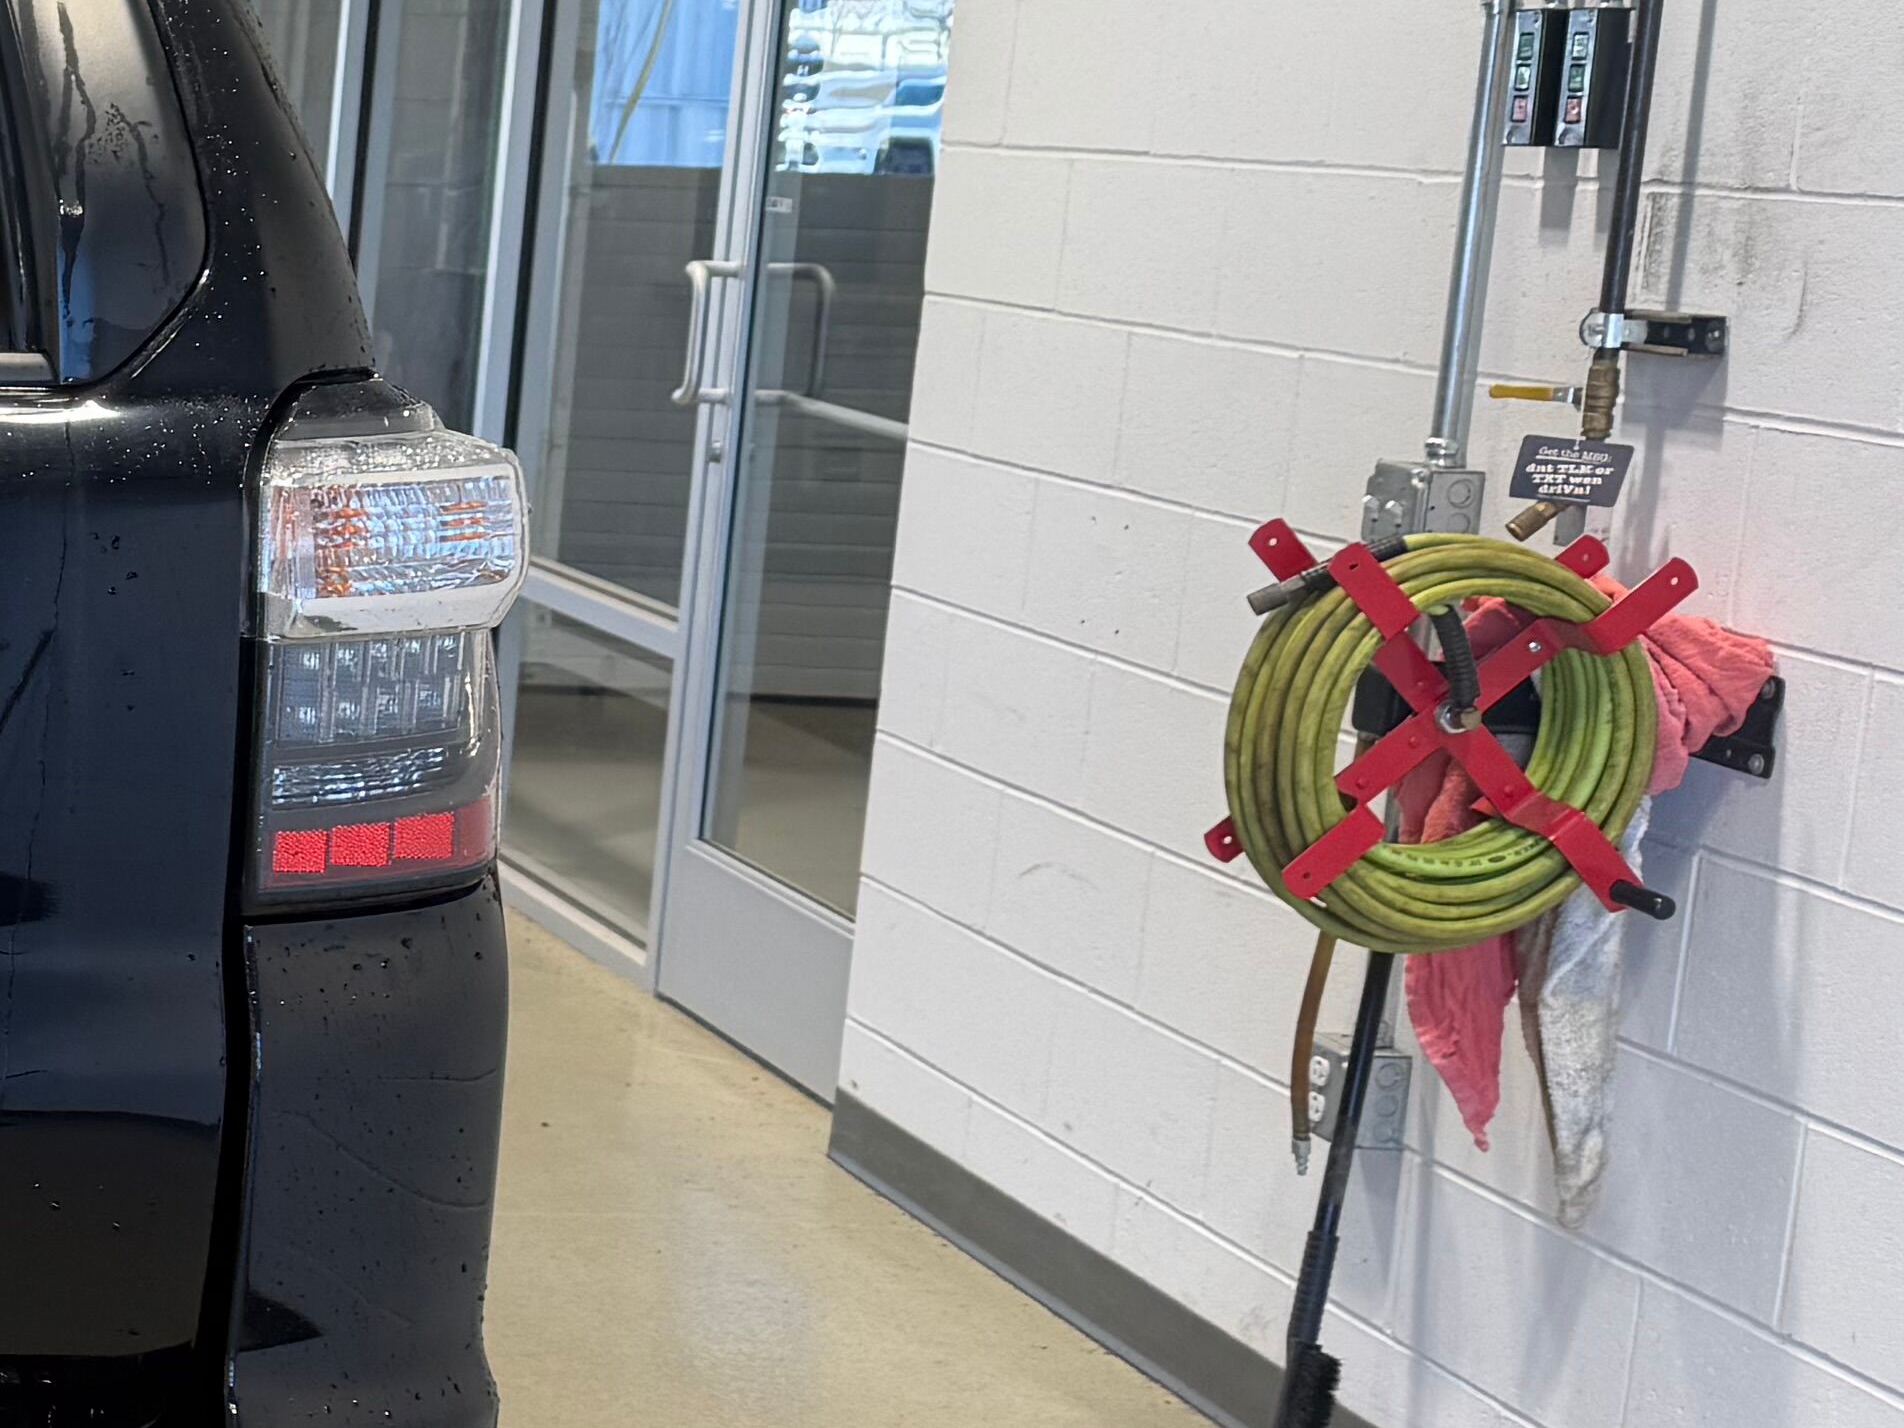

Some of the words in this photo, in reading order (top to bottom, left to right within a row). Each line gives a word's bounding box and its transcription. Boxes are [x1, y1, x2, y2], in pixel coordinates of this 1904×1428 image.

[1538, 446, 1559, 457] Get
[1560, 448, 1580, 459] the
[1594, 466, 1615, 476] or
[1531, 473, 1567, 484] TXT
